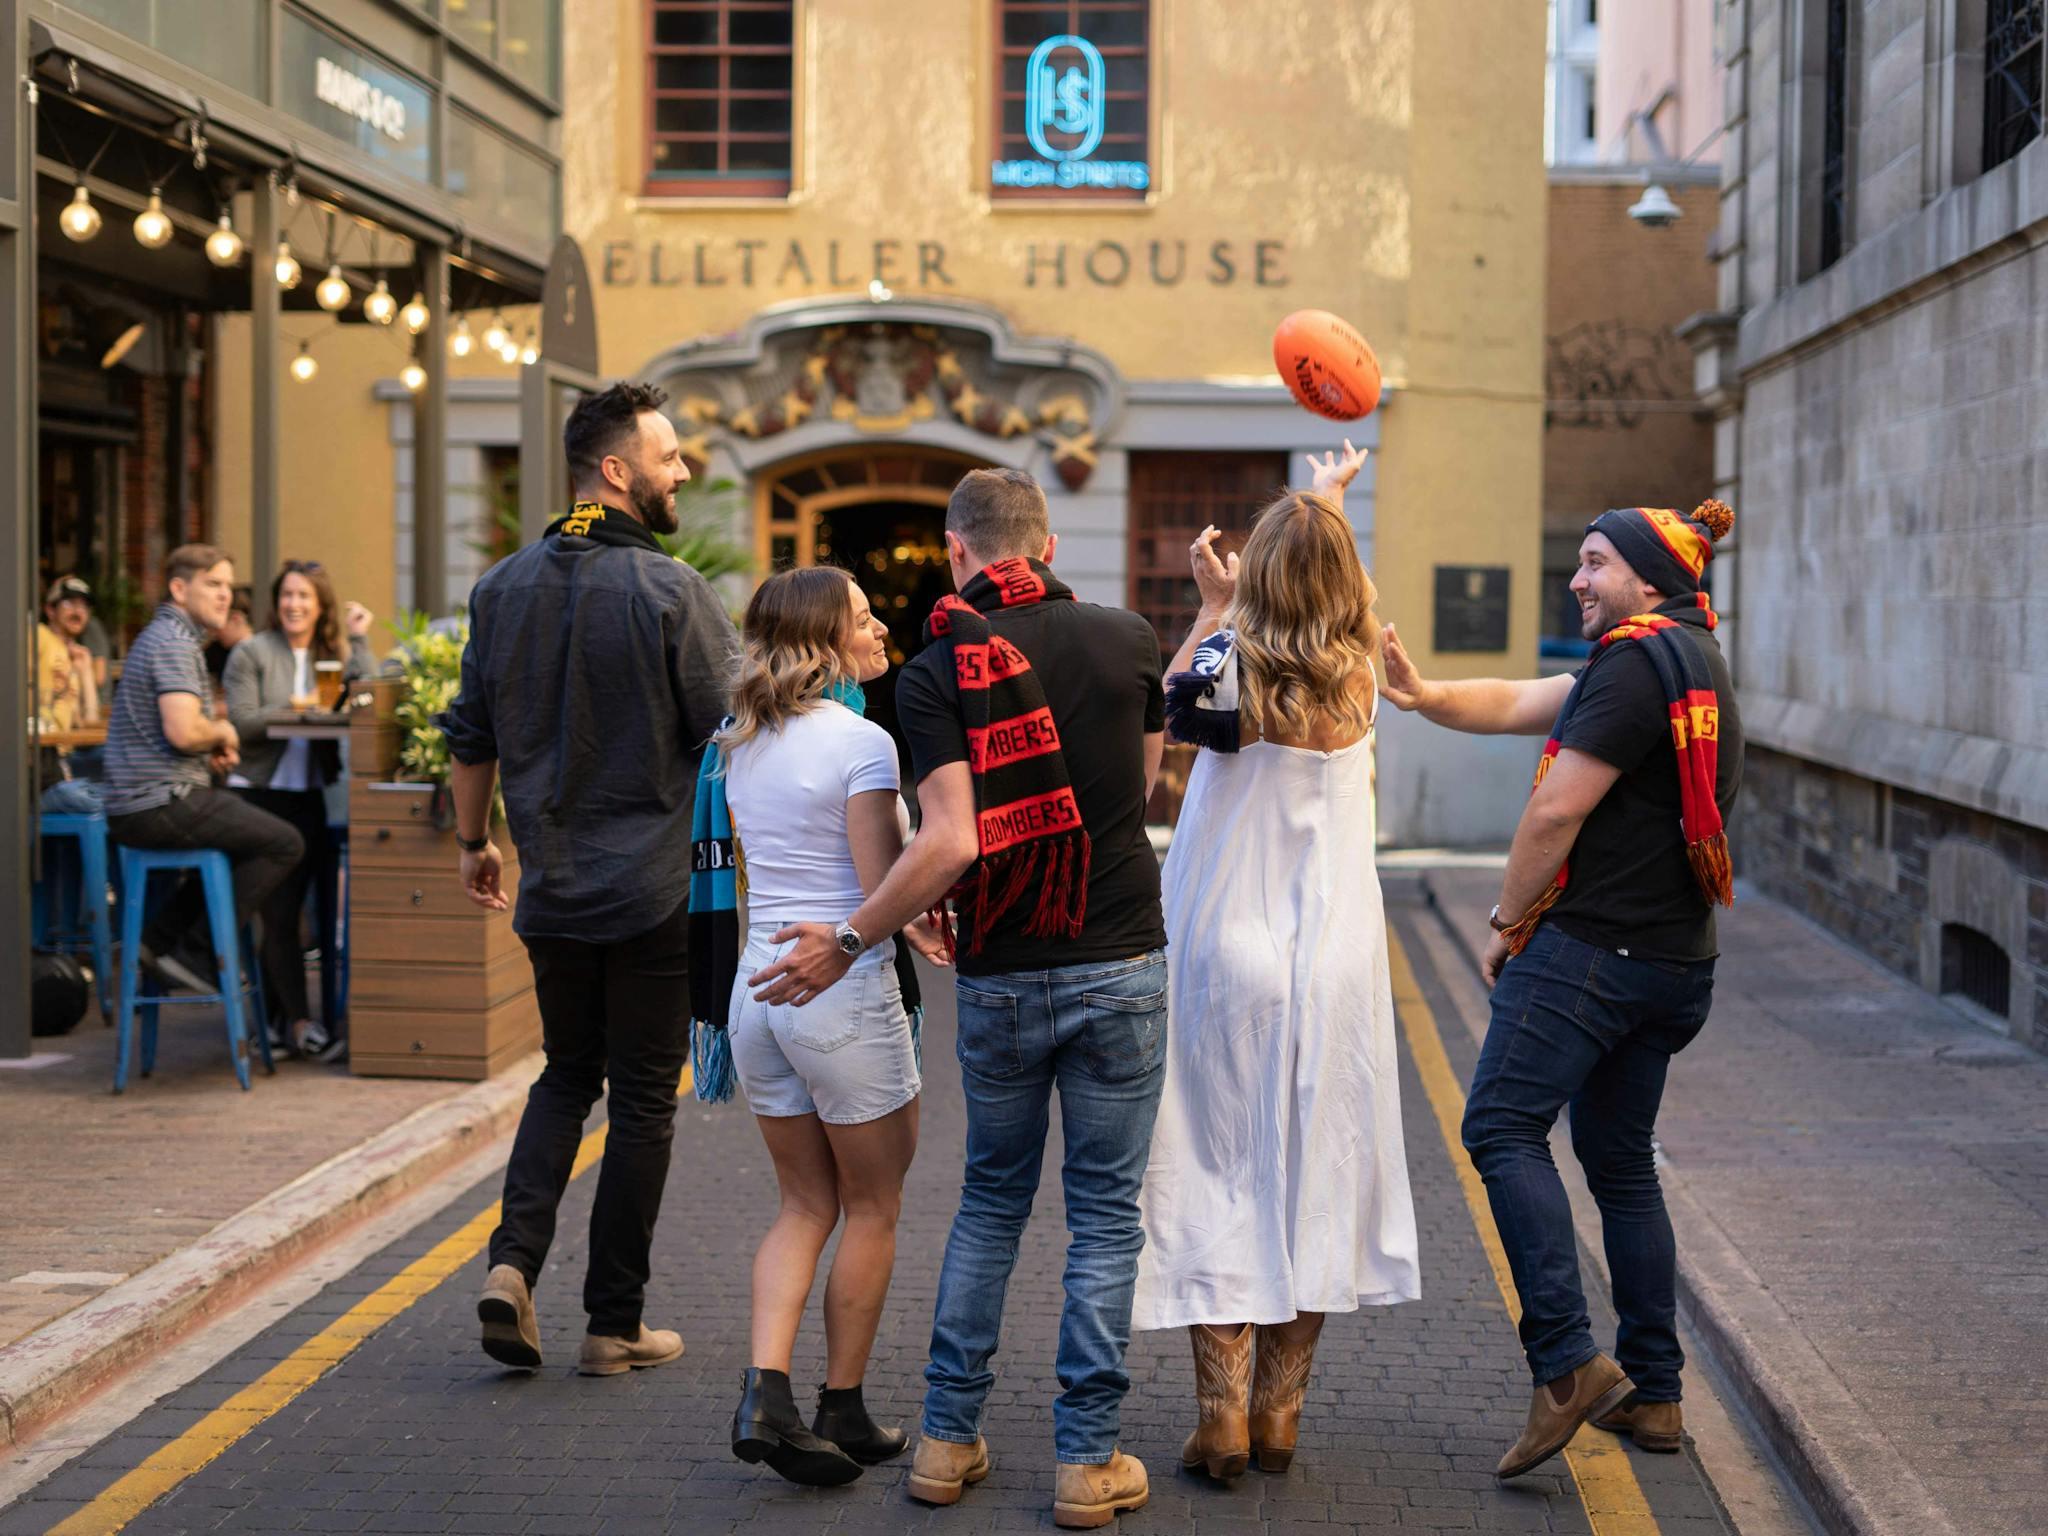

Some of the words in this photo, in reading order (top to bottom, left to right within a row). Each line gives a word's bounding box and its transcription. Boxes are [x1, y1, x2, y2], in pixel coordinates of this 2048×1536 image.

[602, 238, 955, 288] ELLTALER
[1023, 238, 1291, 288] HOUSE
[983, 795, 1076, 847] BOMBERS
